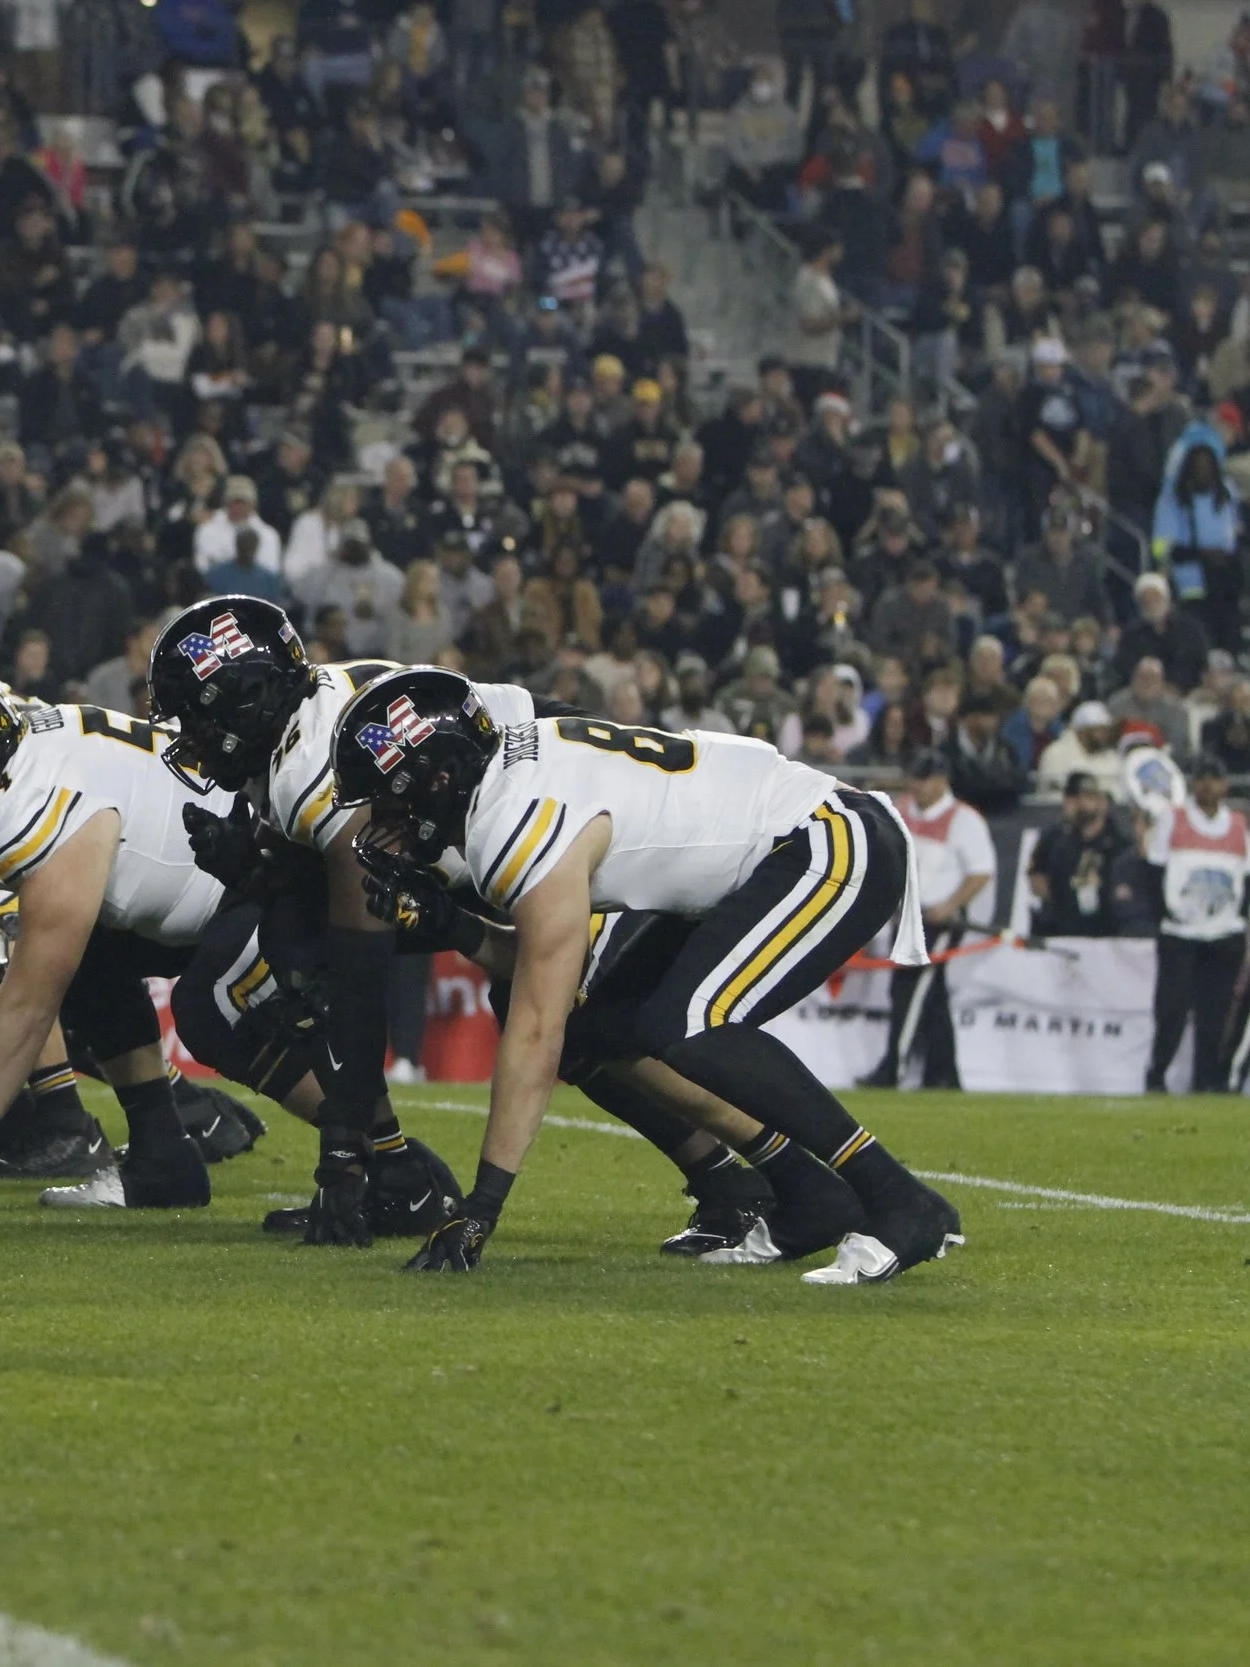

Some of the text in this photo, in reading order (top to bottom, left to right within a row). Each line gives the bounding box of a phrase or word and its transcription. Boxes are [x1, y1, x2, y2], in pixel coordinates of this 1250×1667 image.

[178, 612, 254, 681] M
[356, 694, 436, 774] M
[993, 1011, 1122, 1037] MARTIN
